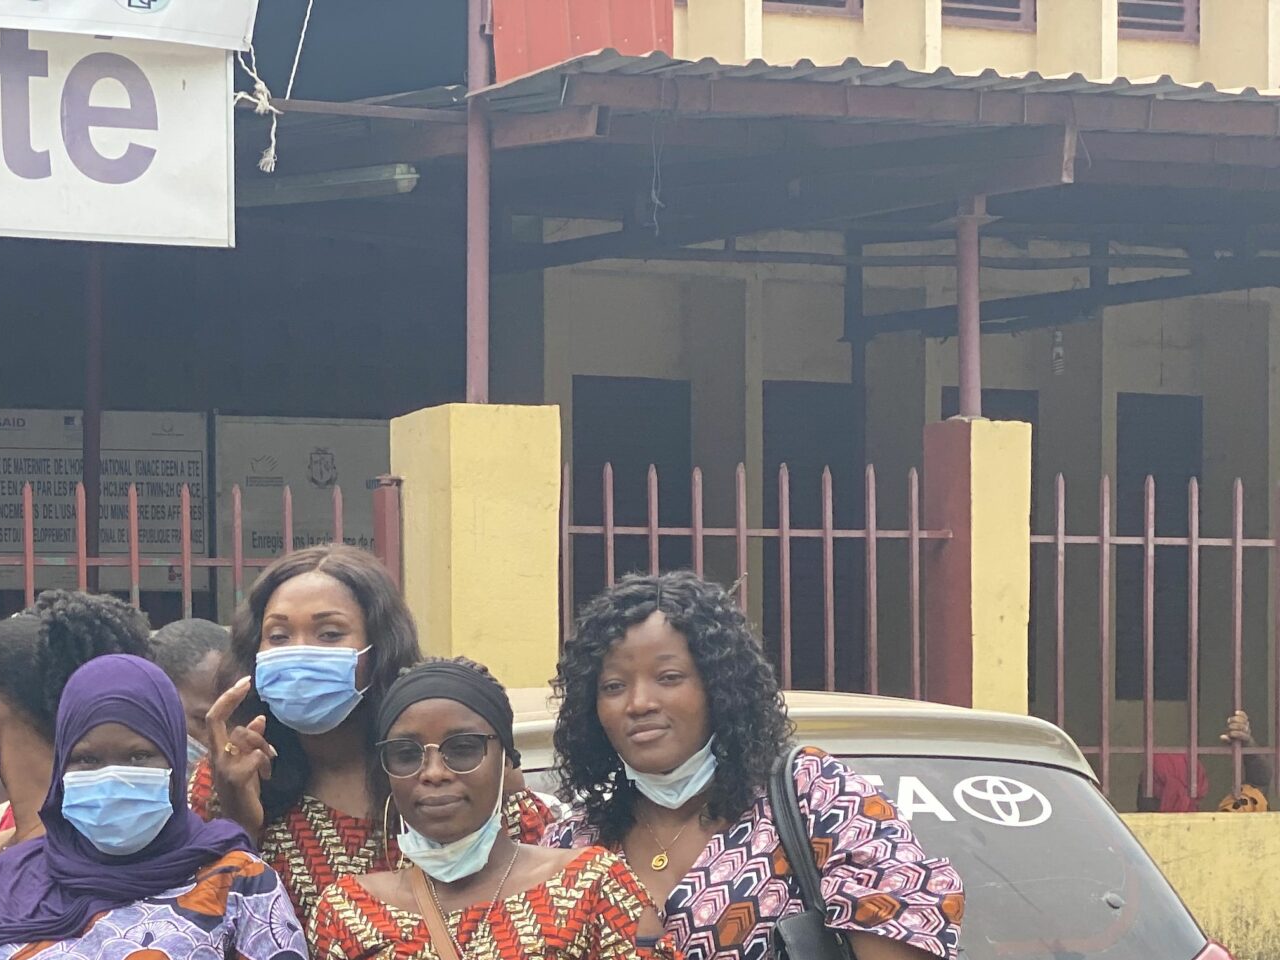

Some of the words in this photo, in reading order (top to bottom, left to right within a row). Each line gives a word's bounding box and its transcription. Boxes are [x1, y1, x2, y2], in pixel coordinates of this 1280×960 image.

[3, 458, 12, 474] DE
[14, 458, 50, 474] MATERNITE
[54, 458, 63, 475] DE
[101, 459, 132, 476] NATIONAL
[135, 459, 160, 476] IGNACE
[161, 460, 179, 476] DEEN
[180, 460, 186, 476] A
[187, 460, 200, 477] ETE
[8, 480, 18, 496] EN
[37, 481, 52, 497] PAR
[53, 481, 68, 497] LES
[42, 503, 53, 519] DE
[98, 504, 109, 520] DU
[151, 505, 166, 521] DES
